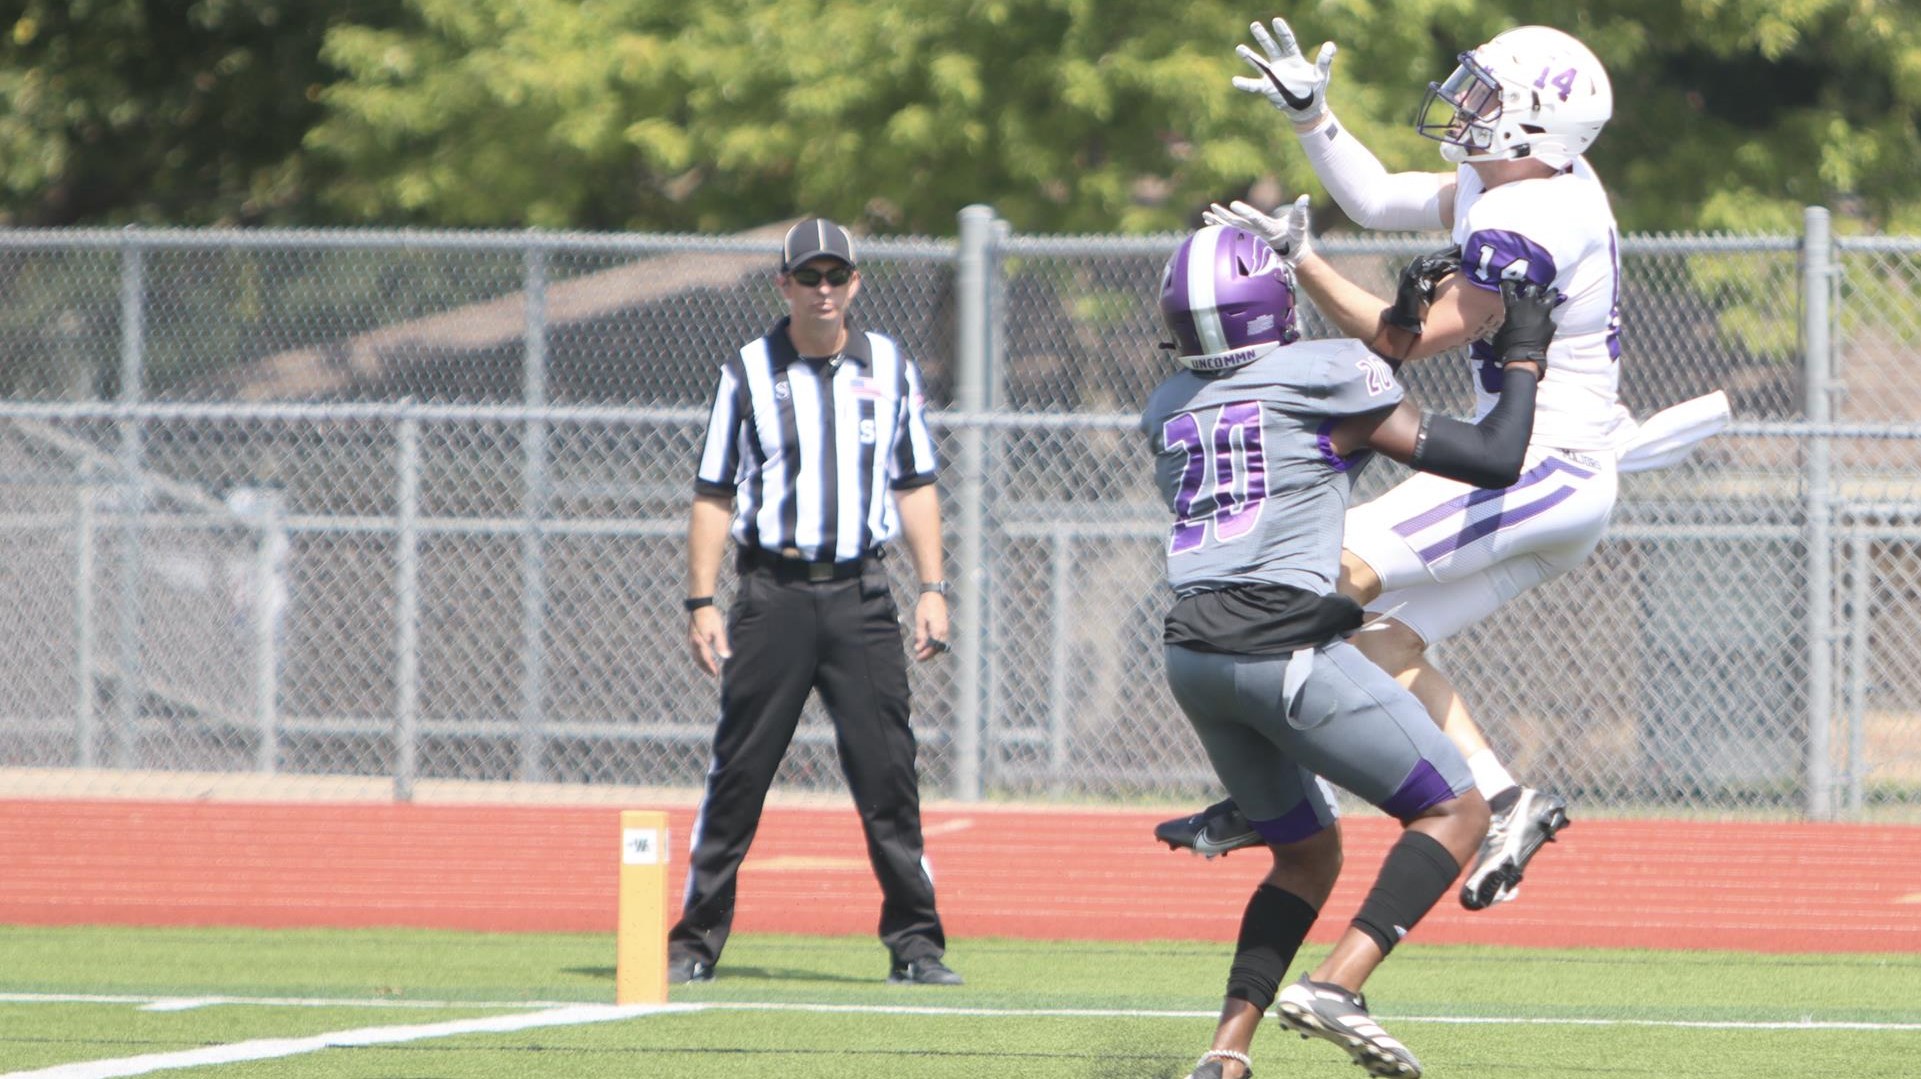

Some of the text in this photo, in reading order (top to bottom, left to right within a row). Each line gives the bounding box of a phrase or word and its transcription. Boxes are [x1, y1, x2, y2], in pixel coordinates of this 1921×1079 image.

[1533, 66, 1577, 102] 14
[1474, 243, 1530, 283] 14
[1191, 349, 1257, 369] UNCOMMN
[1355, 355, 1393, 397] 20
[859, 419, 876, 443] S
[1163, 401, 1270, 557] 20
